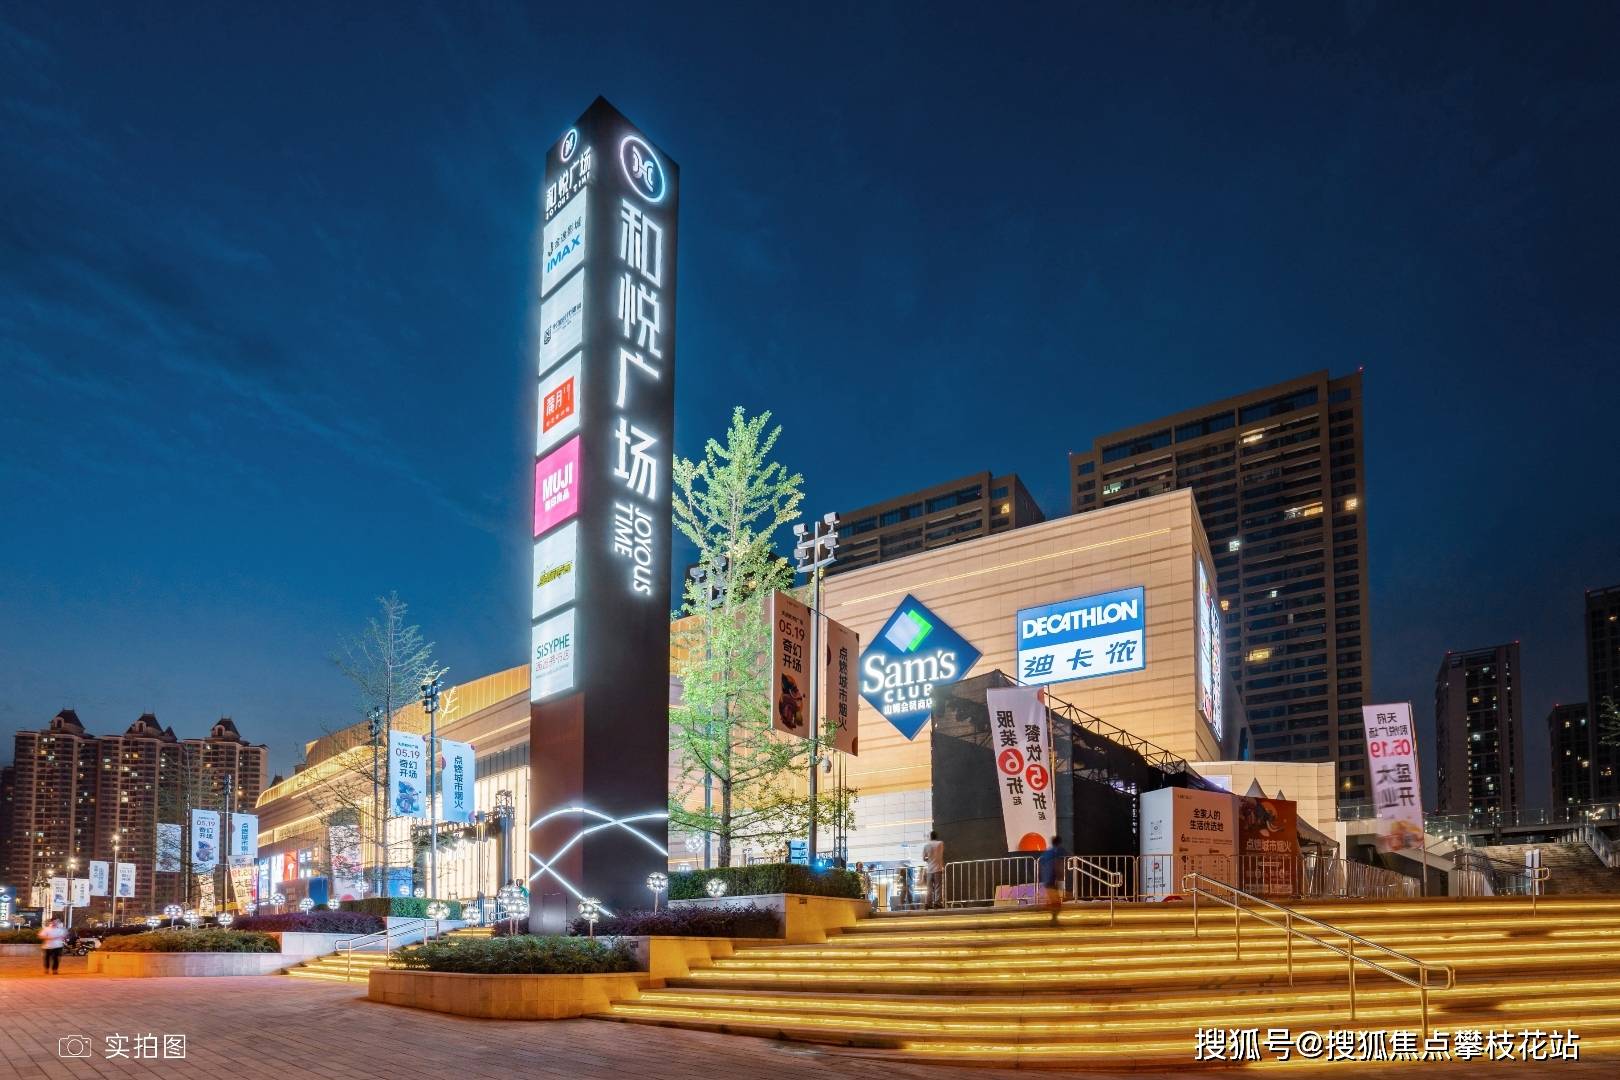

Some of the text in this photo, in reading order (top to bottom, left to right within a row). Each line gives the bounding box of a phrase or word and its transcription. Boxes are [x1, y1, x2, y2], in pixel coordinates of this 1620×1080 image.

[546, 146, 591, 212] 和悦广场
[547, 235, 581, 273] IMAX
[614, 198, 663, 500] 和悦广场
[542, 461, 573, 503] MUJI
[615, 502, 633, 558] TIME
[634, 507, 652, 596] JOYOUS
[779, 619, 805, 642] 05.19
[1022, 599, 1138, 639] DECATHLON
[782, 638, 802, 659] 奇幻
[783, 654, 802, 674] 开场
[1023, 639, 1138, 678] 迪卡侬
[863, 650, 956, 693] Sam's
[395, 748, 420, 761] 05.19
[399, 759, 418, 770] 奇幻
[399, 768, 418, 779] 开场
[1193, 808, 1221, 820] 全家人的
